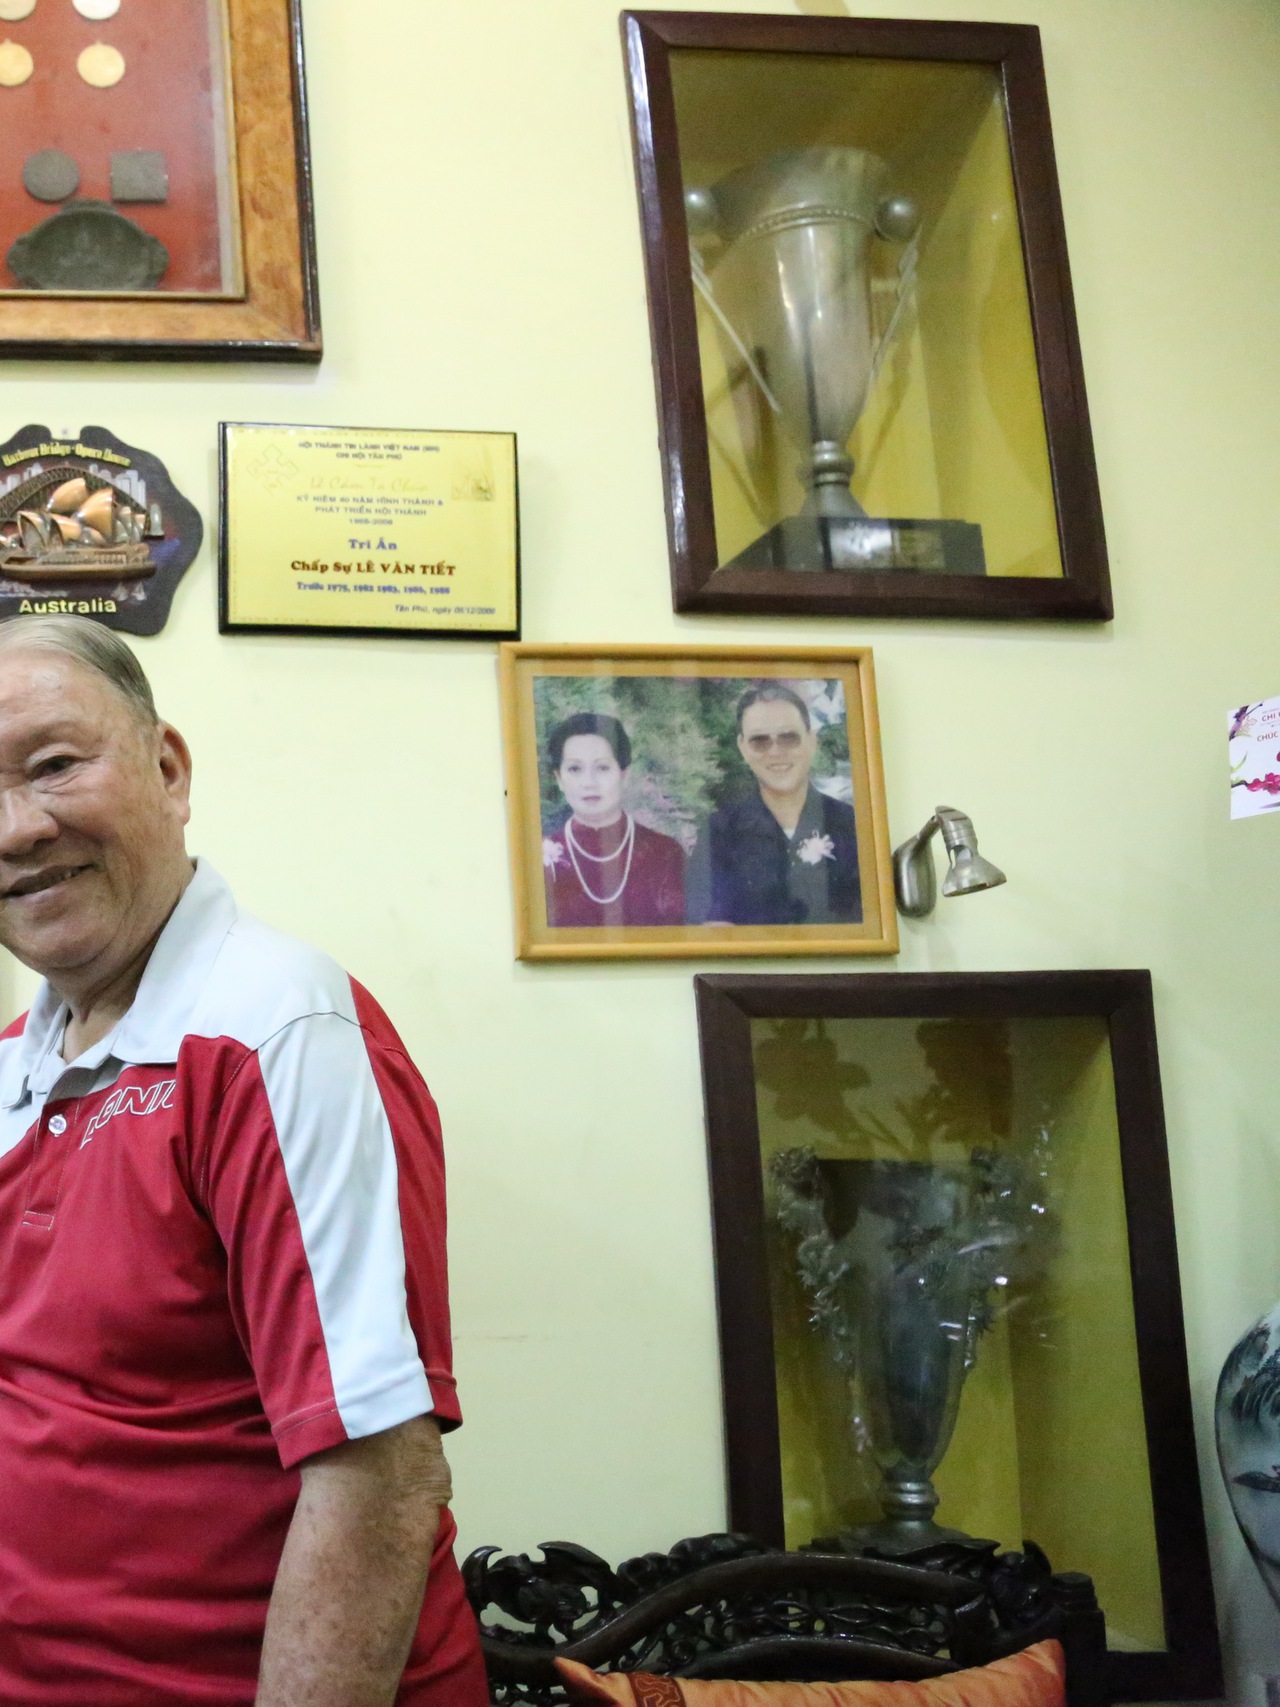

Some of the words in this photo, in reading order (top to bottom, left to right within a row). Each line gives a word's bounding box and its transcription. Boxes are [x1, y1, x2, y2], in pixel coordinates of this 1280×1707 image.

[39, 441, 71, 456] Bridge
[75, 443, 103, 458] Opera
[103, 448, 131, 467] House
[348, 539, 371, 549] Tri
[376, 537, 398, 550] Ân
[290, 559, 329, 574] Chấp
[333, 561, 352, 576] Sự
[356, 560, 375, 573] LÊ
[380, 562, 415, 574] VĂN
[419, 560, 457, 576] TIẾT
[19, 598, 117, 613] Australia
